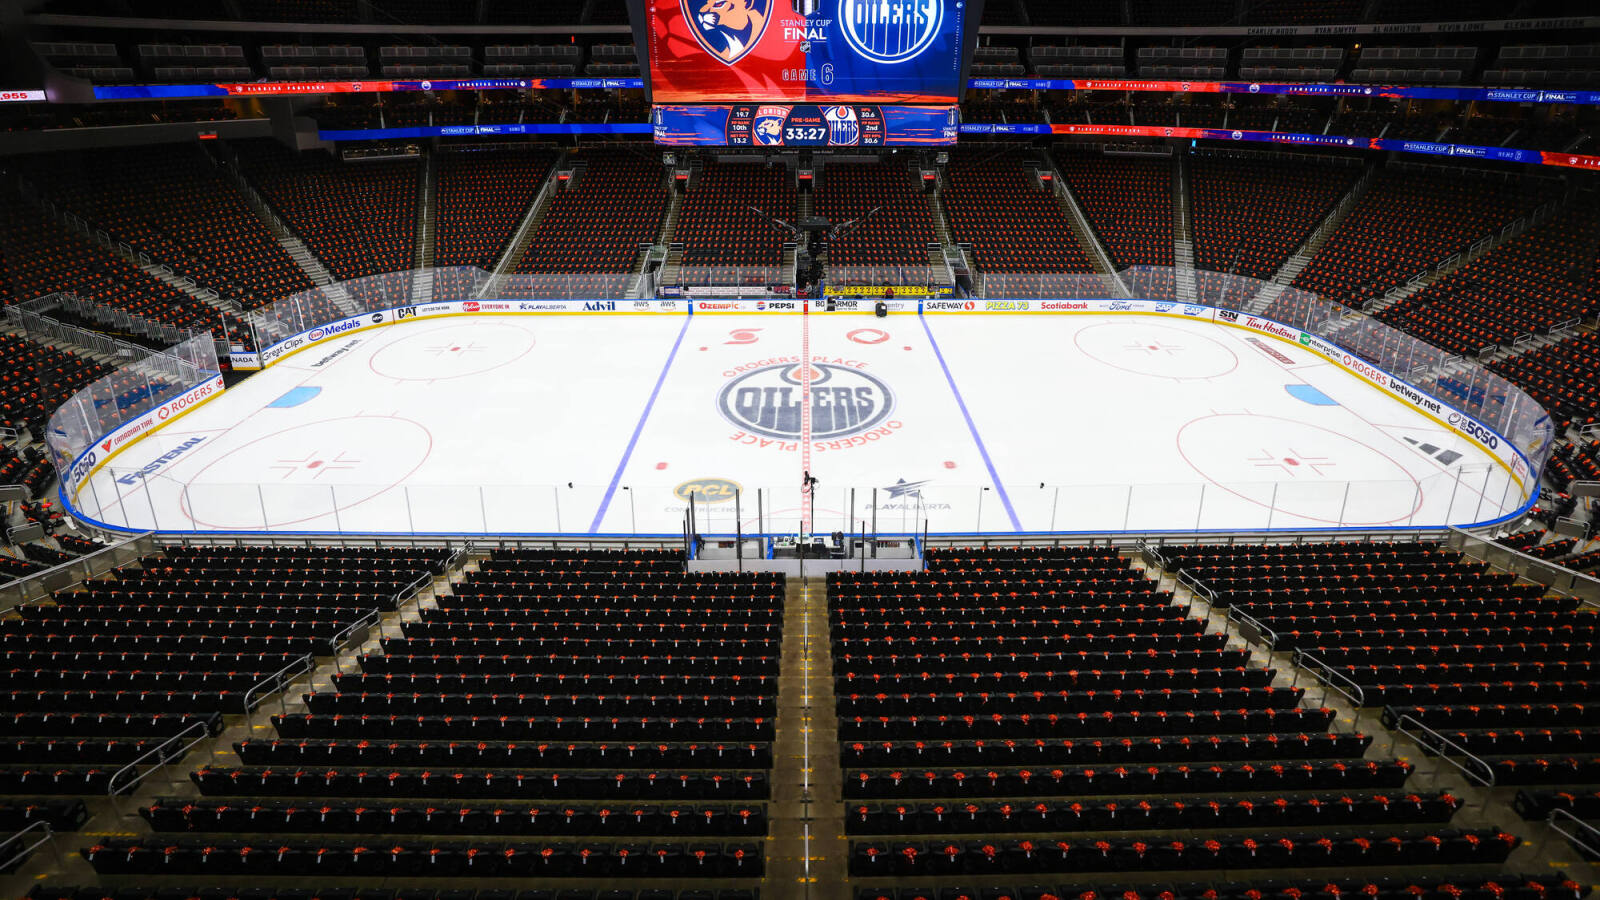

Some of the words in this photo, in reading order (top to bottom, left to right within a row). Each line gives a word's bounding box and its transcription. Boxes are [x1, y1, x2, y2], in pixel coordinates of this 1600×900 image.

[780, 19, 815, 27] STANLEY
[815, 19, 832, 27] CUP
[853, 0, 930, 34] OILERS
[784, 27, 828, 40] FINAL
[782, 69, 816, 81] GAME
[821, 63, 834, 85] 6
[786, 128, 827, 140] 33:27
[397, 306, 417, 319] CAT
[583, 301, 616, 311] Advil
[986, 301, 1016, 310] PIZZA
[1016, 301, 1030, 310] 73
[1041, 302, 1088, 310] Scotiabank
[1109, 301, 1133, 311] Ford
[1184, 305, 1201, 315] SAP
[1219, 310, 1239, 320] SN
[324, 319, 361, 335] Medals
[1245, 316, 1262, 330] Tim
[1262, 321, 1297, 341] Hortons
[262, 346, 284, 362] Great
[284, 337, 304, 350] Clips
[1303, 335, 1341, 359] enterprise
[734, 355, 801, 373] ROGERS
[812, 355, 871, 370] PLACE
[1352, 360, 1388, 386] ROGERS
[171, 384, 213, 413] ROGERS
[736, 387, 875, 417] OILERS
[1389, 379, 1442, 414] betway.net
[114, 423, 141, 446] CANADIAN
[140, 417, 154, 431] TIRE
[729, 431, 798, 452] PLACE
[814, 427, 893, 452] ROGERS
[1466, 420, 1498, 450] 5050
[116, 436, 208, 486] FASTENAL
[683, 484, 733, 496] PCL
